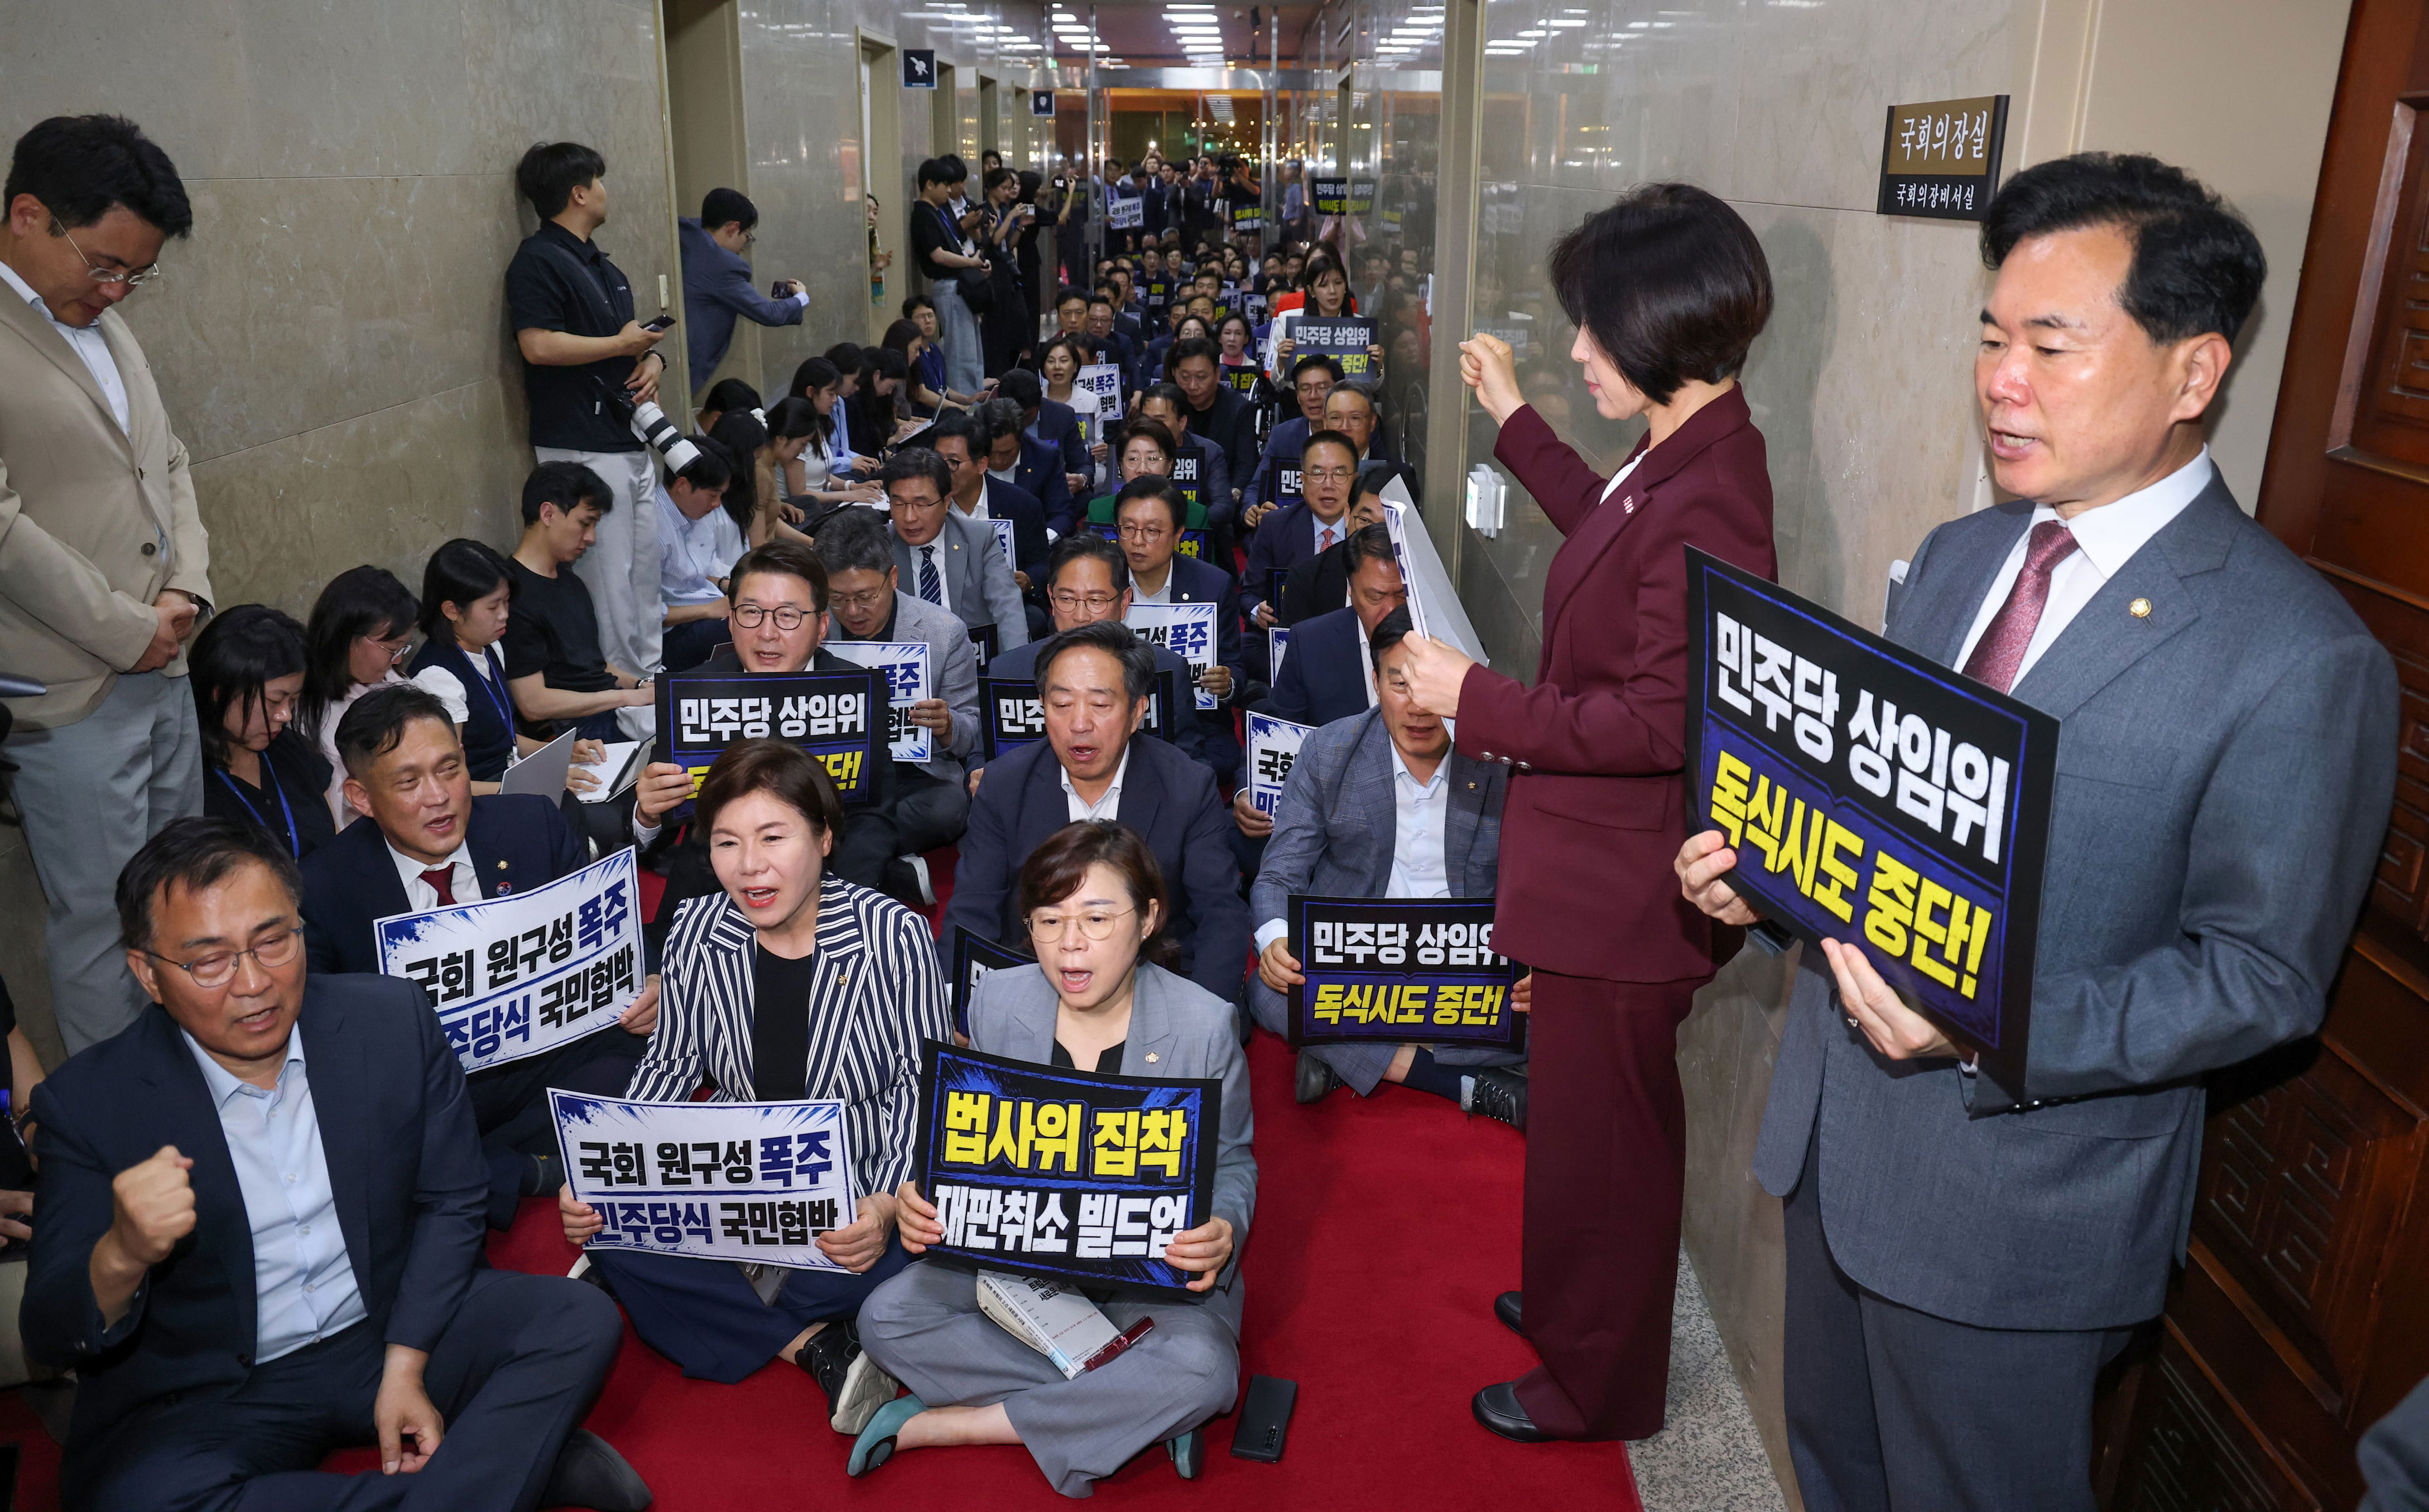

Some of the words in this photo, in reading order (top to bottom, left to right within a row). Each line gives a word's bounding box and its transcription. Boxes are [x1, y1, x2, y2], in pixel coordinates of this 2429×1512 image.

[1901, 110, 1987, 161] 국회의장실
[1897, 182, 1975, 210] 국회의장비서실
[1295, 326, 1331, 345] 민주당
[1334, 326, 1370, 346] 상임위
[1095, 373, 1115, 392] 폭주
[1100, 394, 1117, 412] 협박
[1173, 458, 1197, 480] 임위
[1170, 621, 1208, 658] 폭주
[680, 696, 772, 743] 민주당
[778, 692, 866, 738] 상임위
[1717, 611, 1840, 764] 민주당
[1848, 687, 2010, 865] 상임위
[1710, 750, 1865, 924] 독식시도
[1865, 849, 1993, 1000] 중단!
[405, 949, 474, 1007] 국회
[487, 912, 573, 990] 원구성
[578, 878, 629, 950] 폭주
[1313, 921, 1410, 965] 민주당
[444, 994, 531, 1059] 주당식
[539, 943, 634, 1029] 국민협박
[1314, 984, 1430, 1025] 독식시도
[1432, 985, 1506, 1025] 중단!
[944, 1091, 1081, 1172] 법사위
[1093, 1110, 1187, 1177] 집착
[579, 1142, 647, 1187] 국회
[657, 1139, 752, 1186] 원구성
[759, 1130, 833, 1187] 폭주
[590, 1202, 714, 1244] 민주당식
[720, 1198, 838, 1246] 국민협박
[935, 1184, 1070, 1254] 재판취소
[1075, 1194, 1188, 1259] 빌드업
[1038, 1287, 1059, 1301] 새로운
